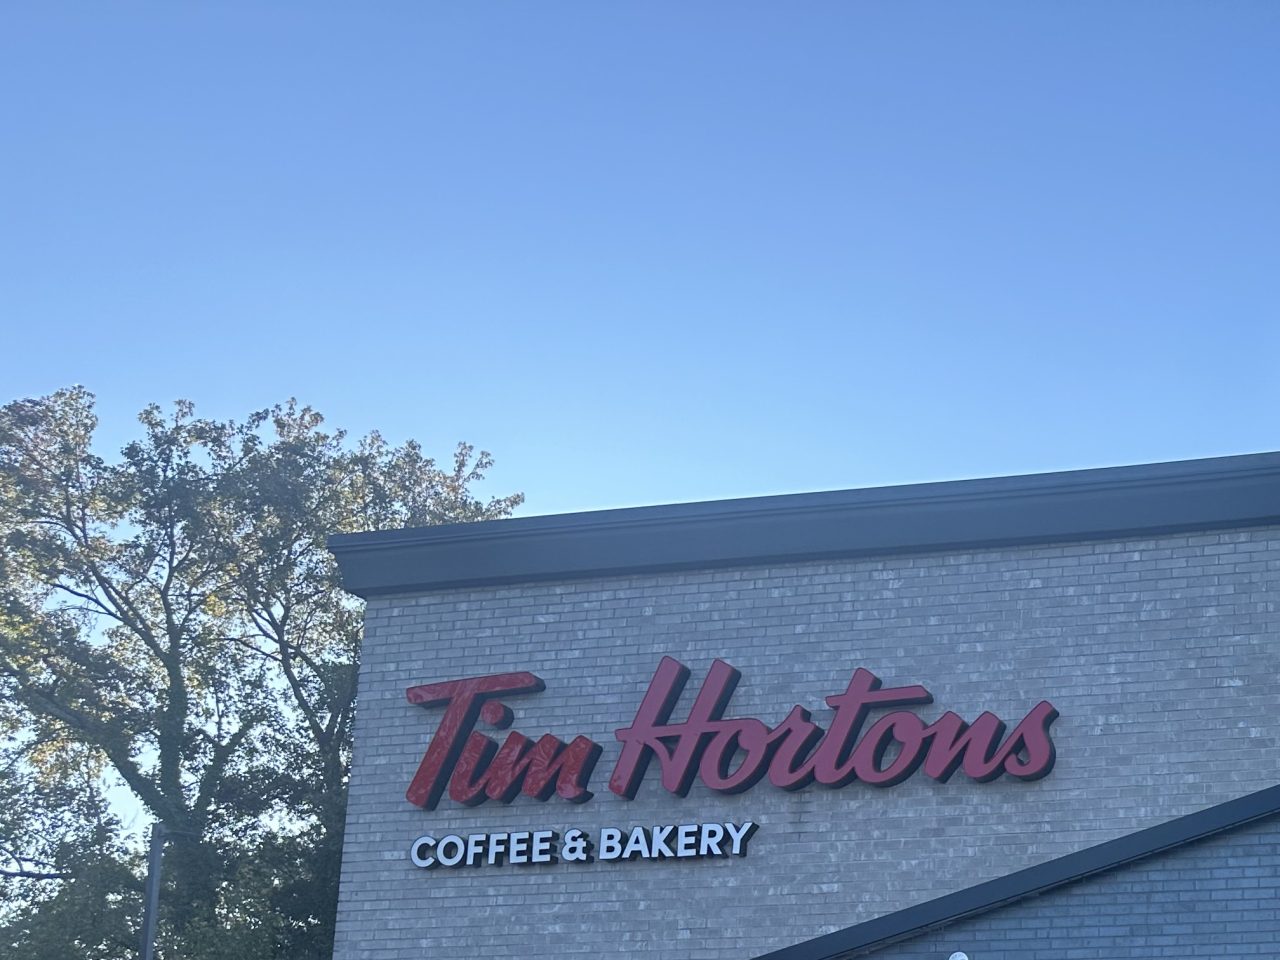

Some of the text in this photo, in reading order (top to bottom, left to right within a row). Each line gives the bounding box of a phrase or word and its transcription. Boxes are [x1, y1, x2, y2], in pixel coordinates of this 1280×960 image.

[406, 655, 1059, 810] Tim Hortons
[410, 822, 758, 869] COFFEE & BAKERY
